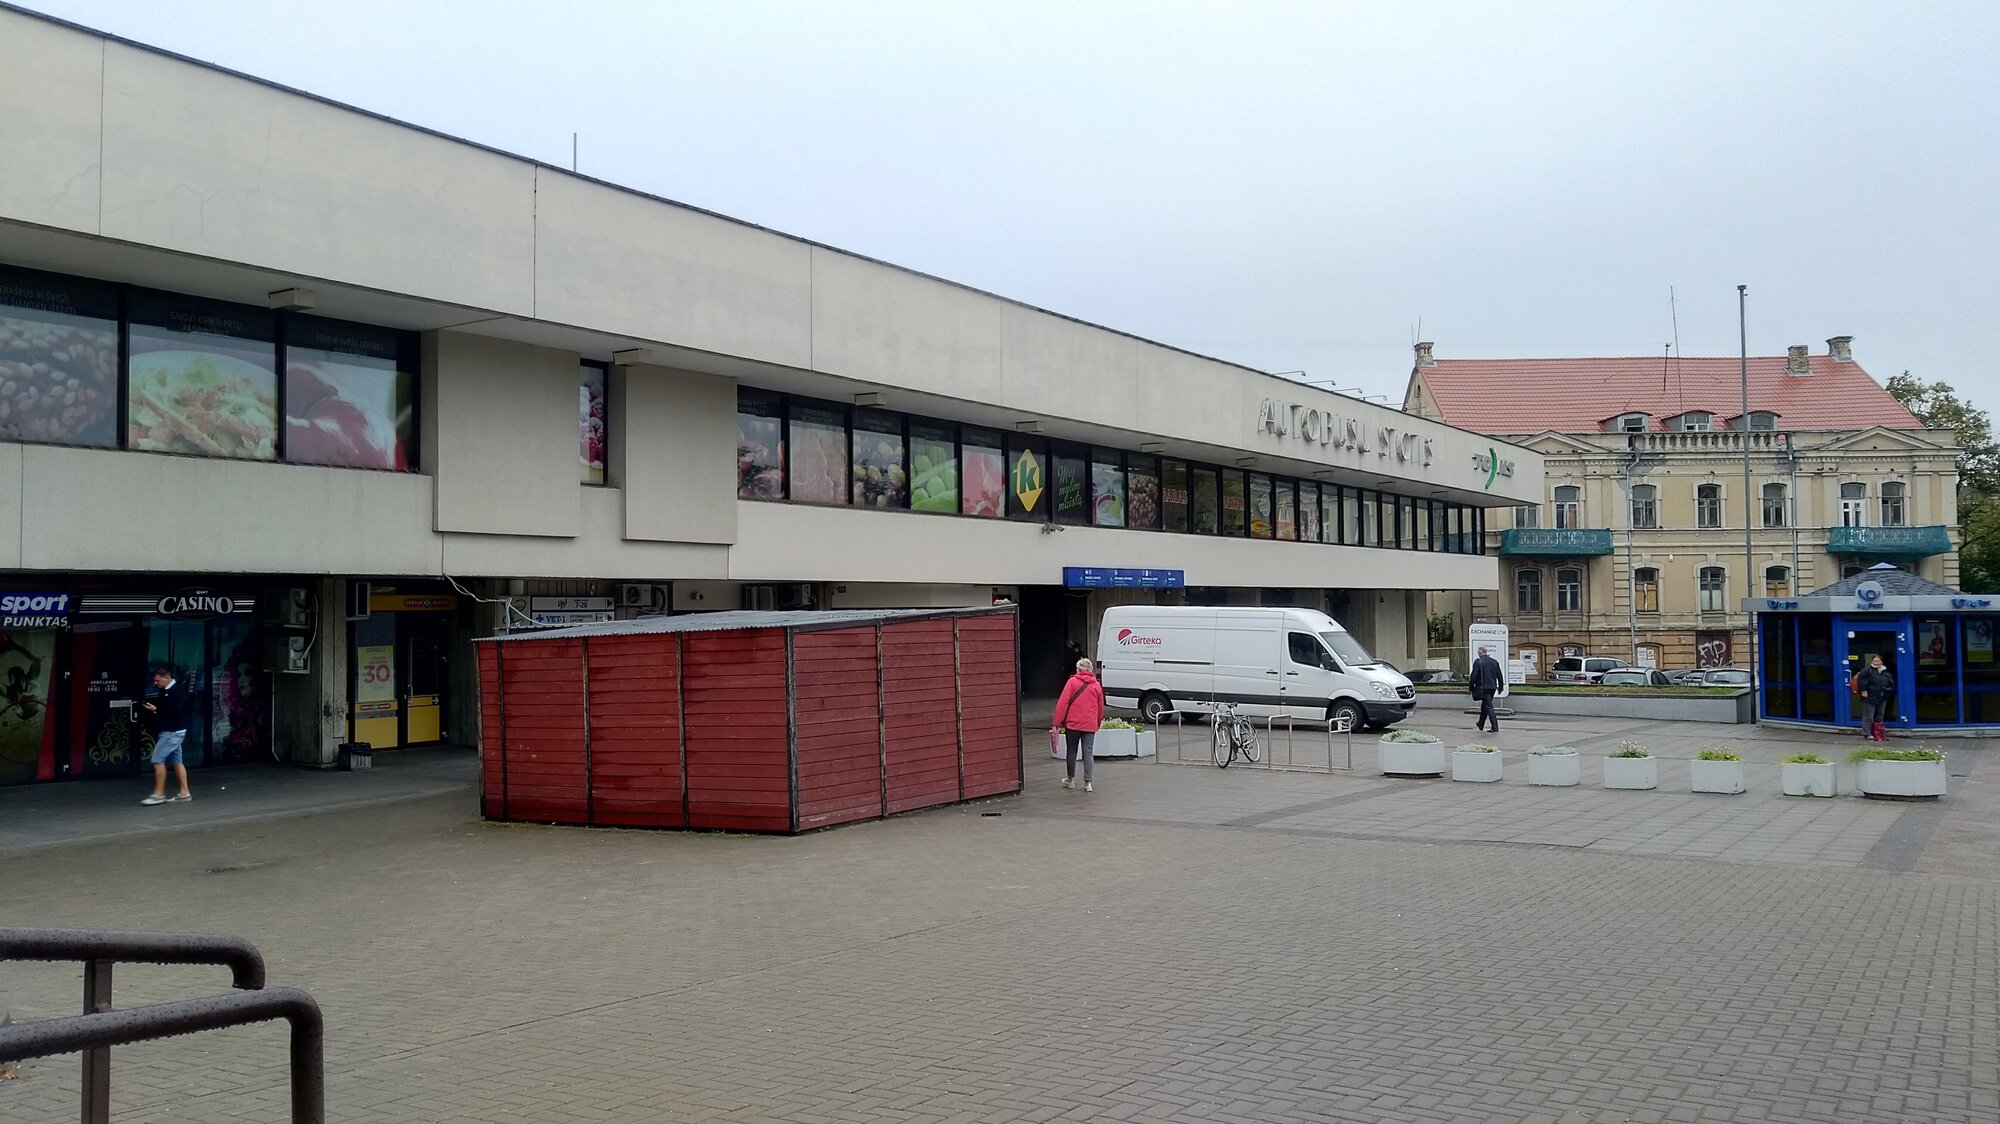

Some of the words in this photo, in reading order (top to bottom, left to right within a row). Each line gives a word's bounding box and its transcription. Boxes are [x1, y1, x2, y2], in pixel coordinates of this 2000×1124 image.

[1378, 425, 1433, 467] STOTIS
[1, 595, 68, 614] sport
[158, 597, 233, 614] CASINO
[4, 617, 68, 626] PUNKTAS
[1131, 635, 1162, 645] Girteka
